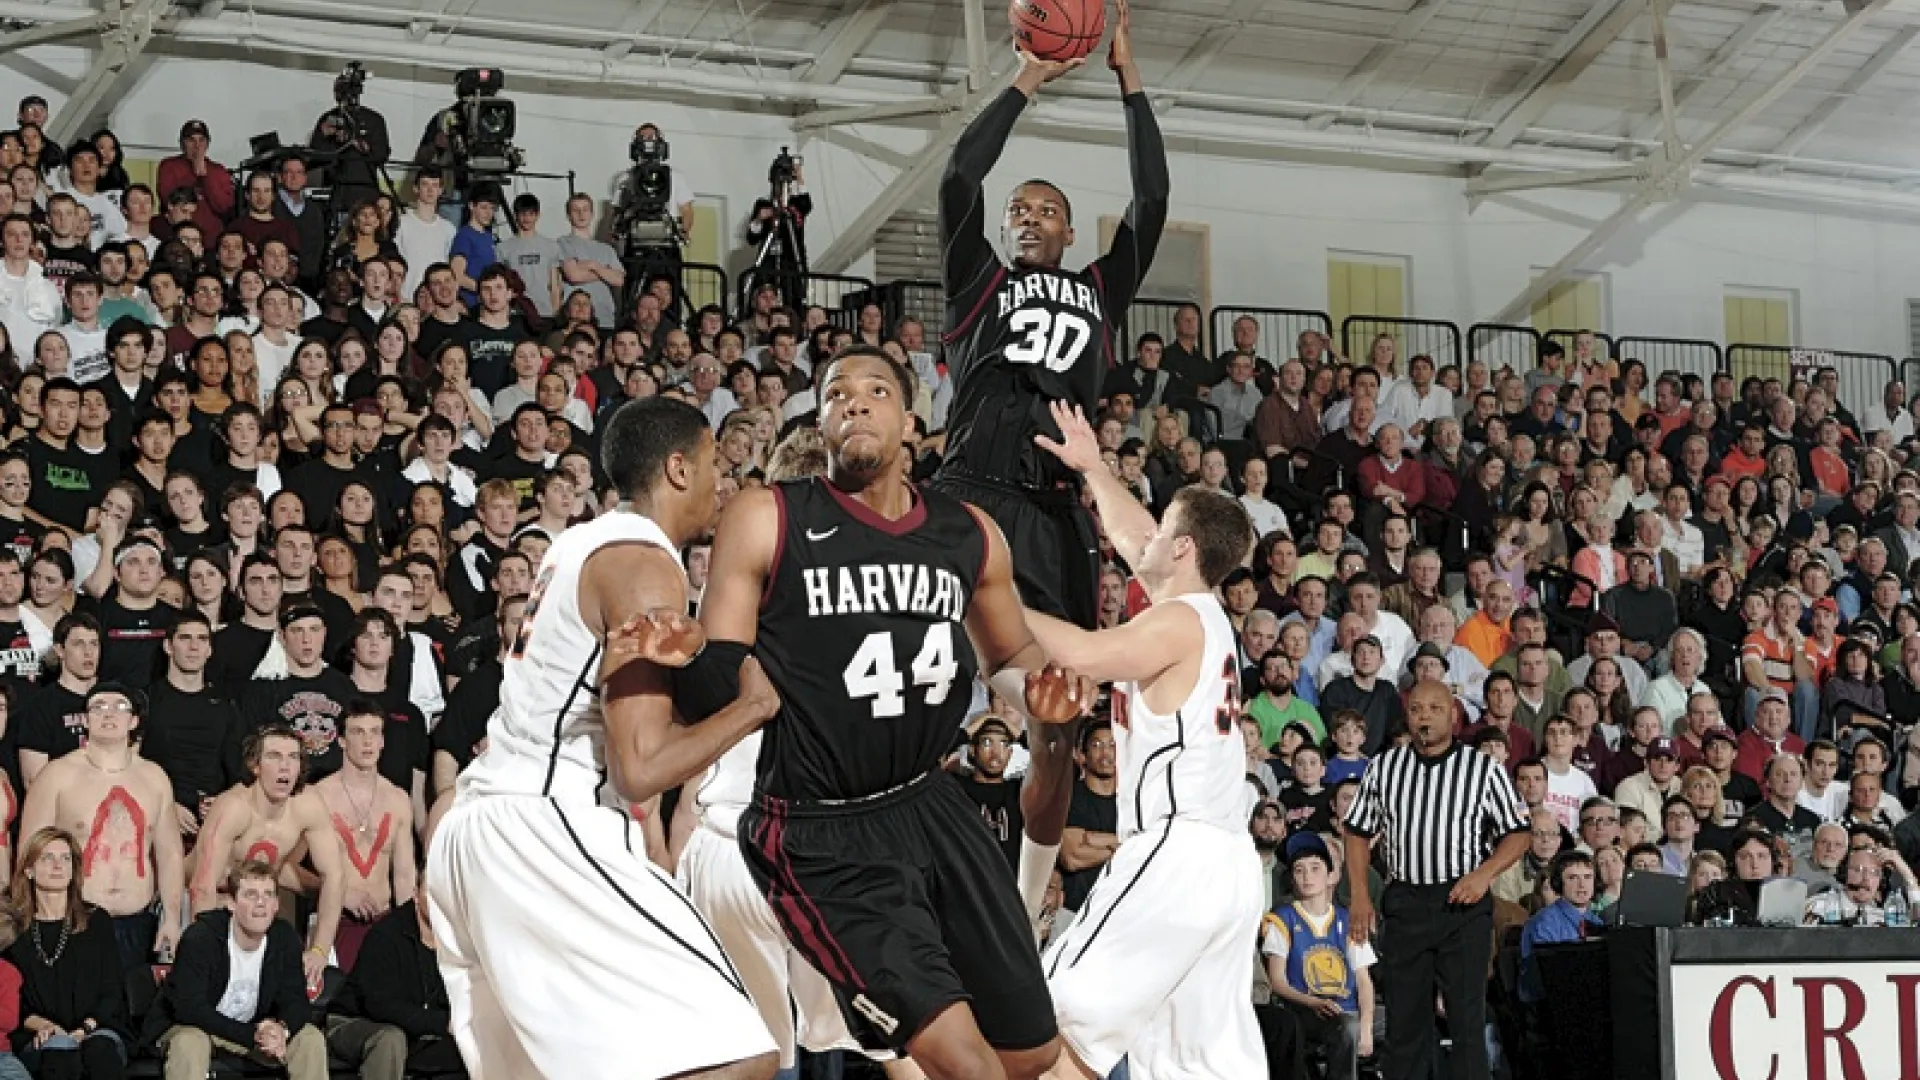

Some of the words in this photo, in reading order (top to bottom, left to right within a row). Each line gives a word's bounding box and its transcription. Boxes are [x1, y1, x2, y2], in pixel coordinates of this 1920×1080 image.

[1003, 307, 1091, 373] 30
[1790, 350, 1835, 367] SECTION
[803, 563, 963, 623] HARVARD
[842, 621, 959, 718] 44
[332, 811, 393, 880] V
[1708, 974, 1920, 1080] CRI
